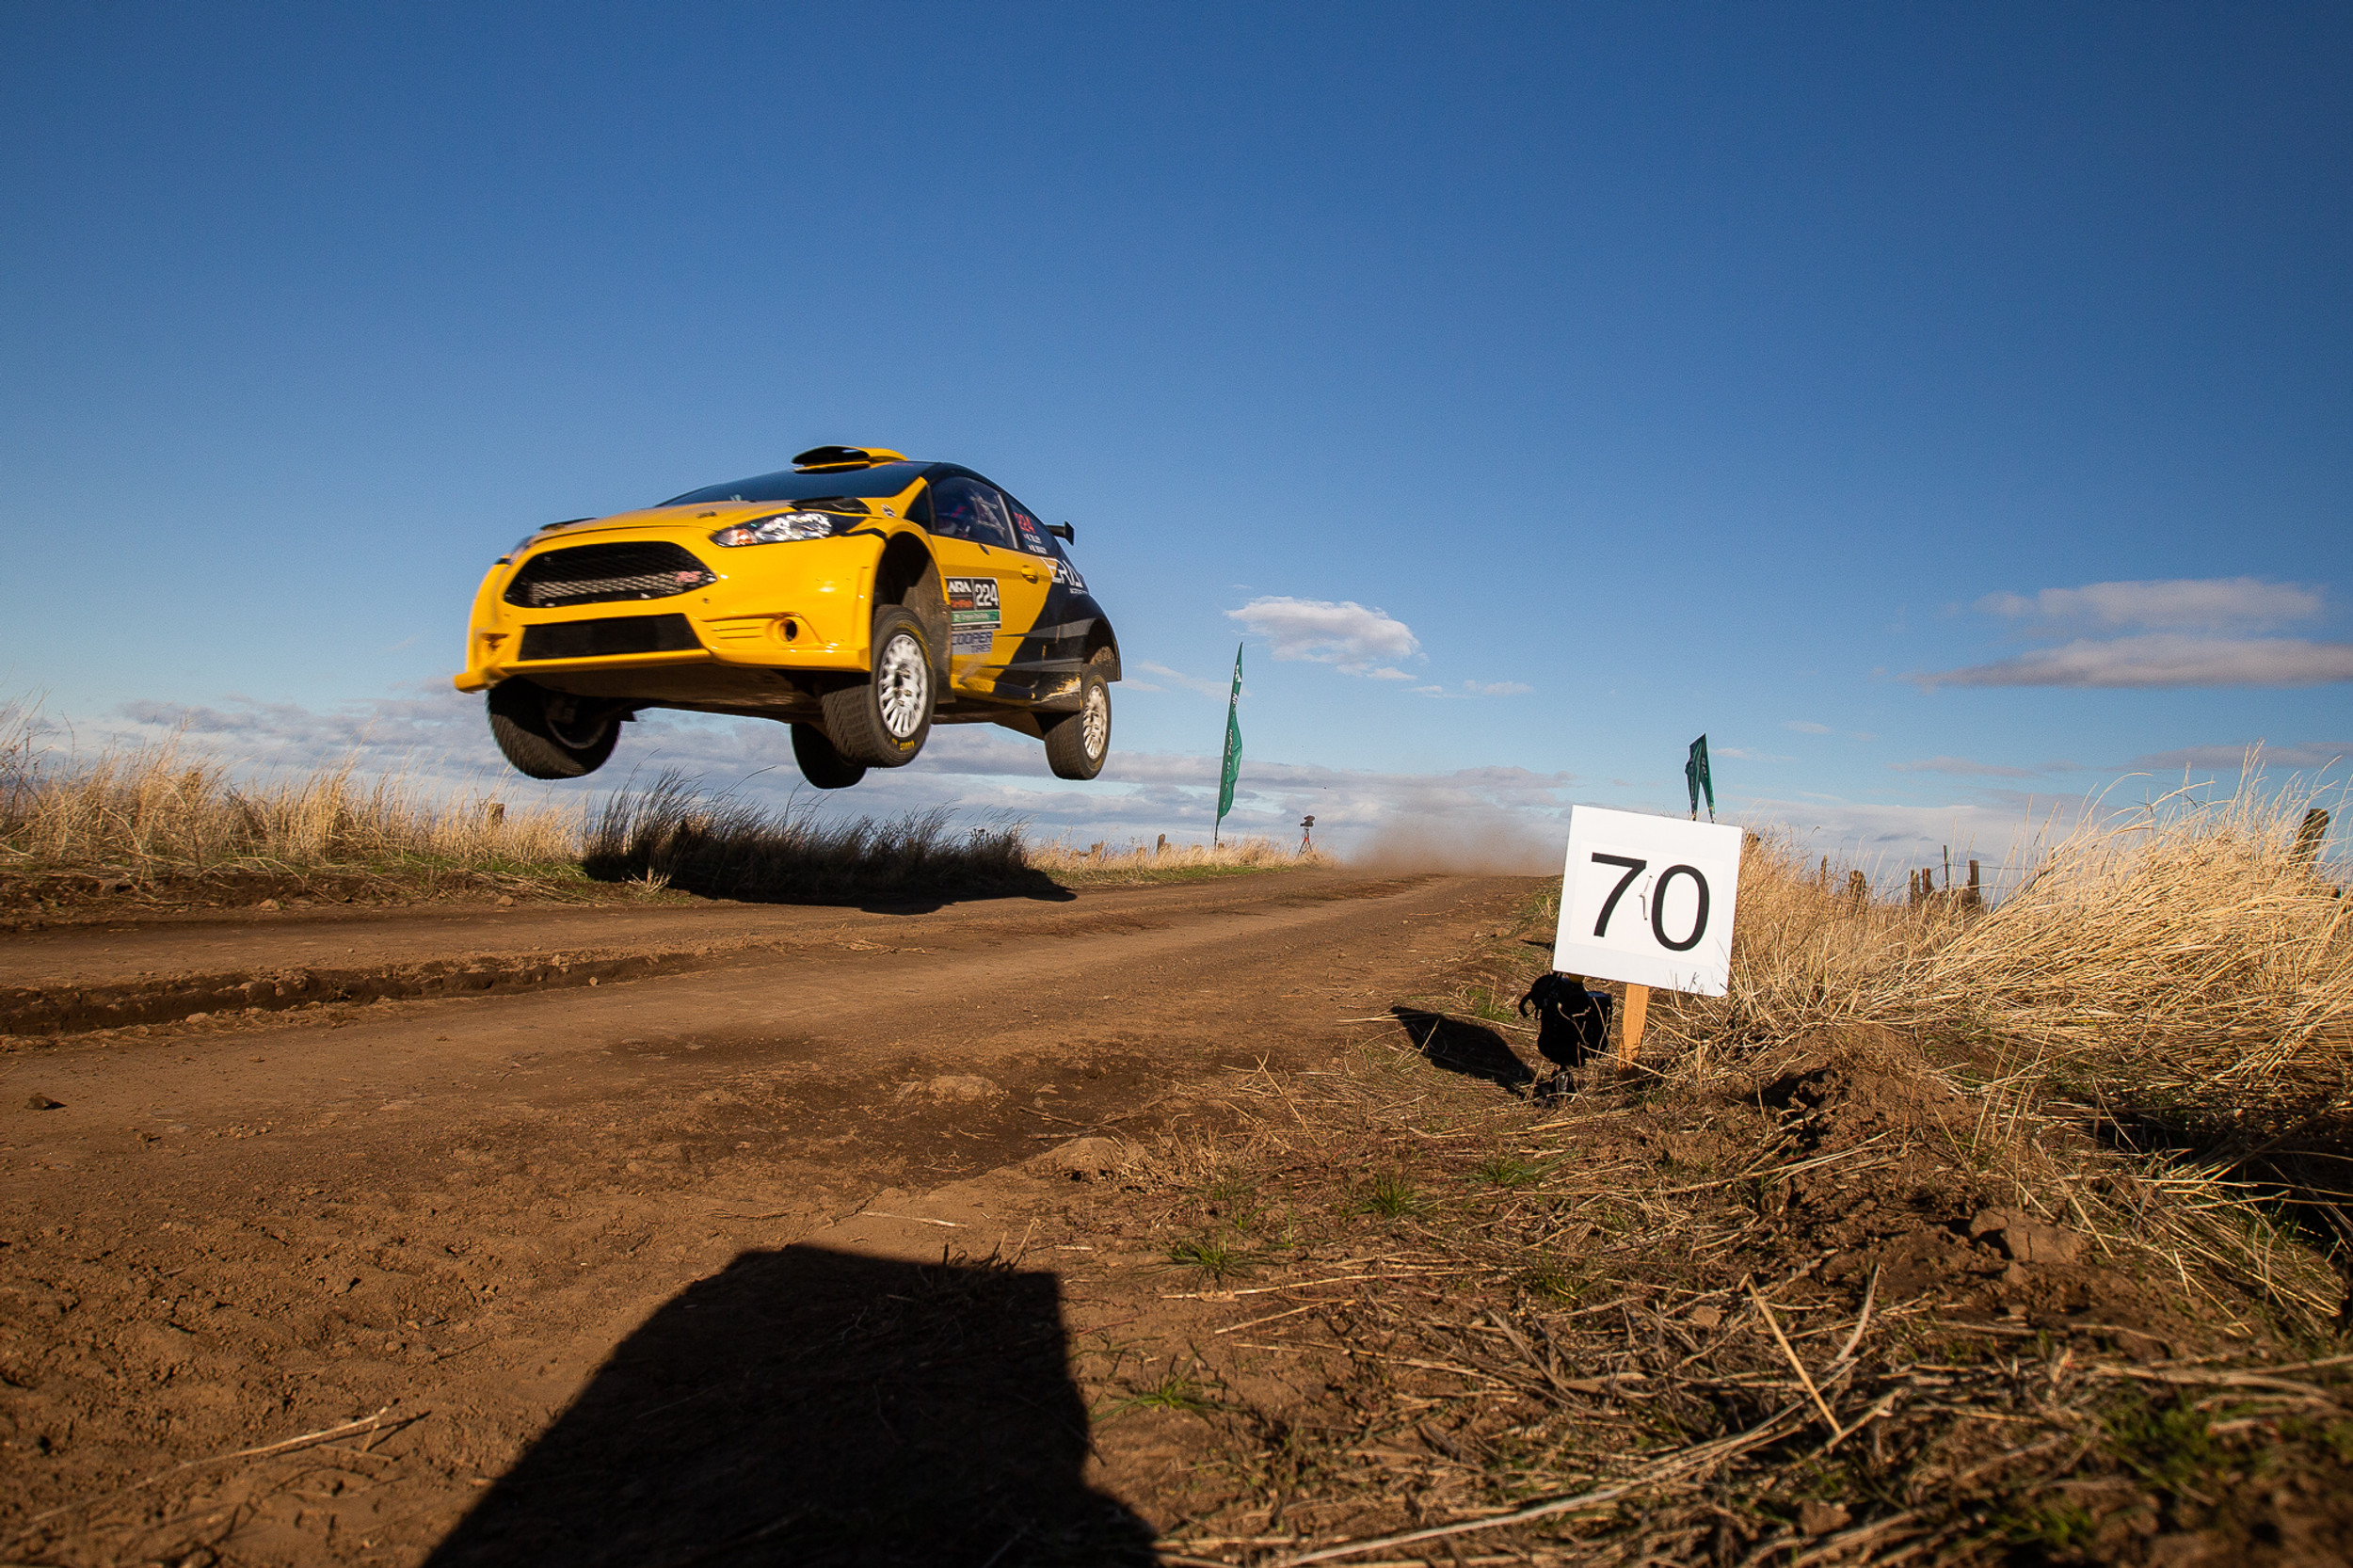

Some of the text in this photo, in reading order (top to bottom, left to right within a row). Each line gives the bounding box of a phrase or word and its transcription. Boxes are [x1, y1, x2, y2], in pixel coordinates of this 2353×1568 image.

[975, 584, 999, 607] 224
[951, 632, 993, 646] COOPER
[1591, 852, 1710, 952] 70
